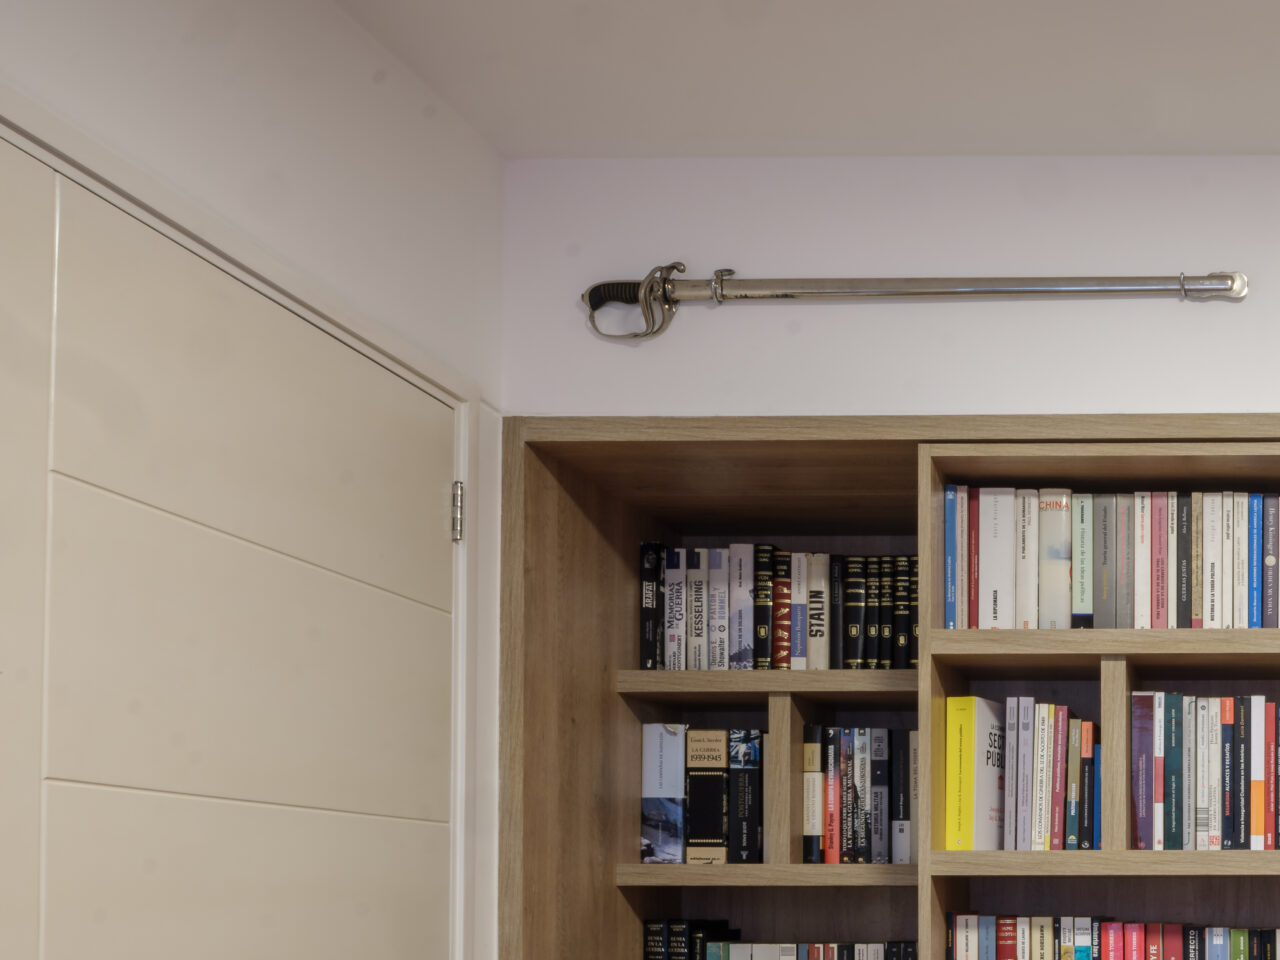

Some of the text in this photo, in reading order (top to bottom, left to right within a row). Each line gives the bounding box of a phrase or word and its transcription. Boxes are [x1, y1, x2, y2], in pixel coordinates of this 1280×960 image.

[1040, 500, 1070, 510] CHINA
[644, 581, 653, 608] ARAFAT
[667, 582, 675, 630] MEMORIAS
[675, 581, 684, 621] GUERRA
[694, 580, 704, 638] KESSELRING
[809, 590, 825, 638] STALIN
[717, 637, 725, 667] Showalter
[1150, 944, 1157, 954] FE
